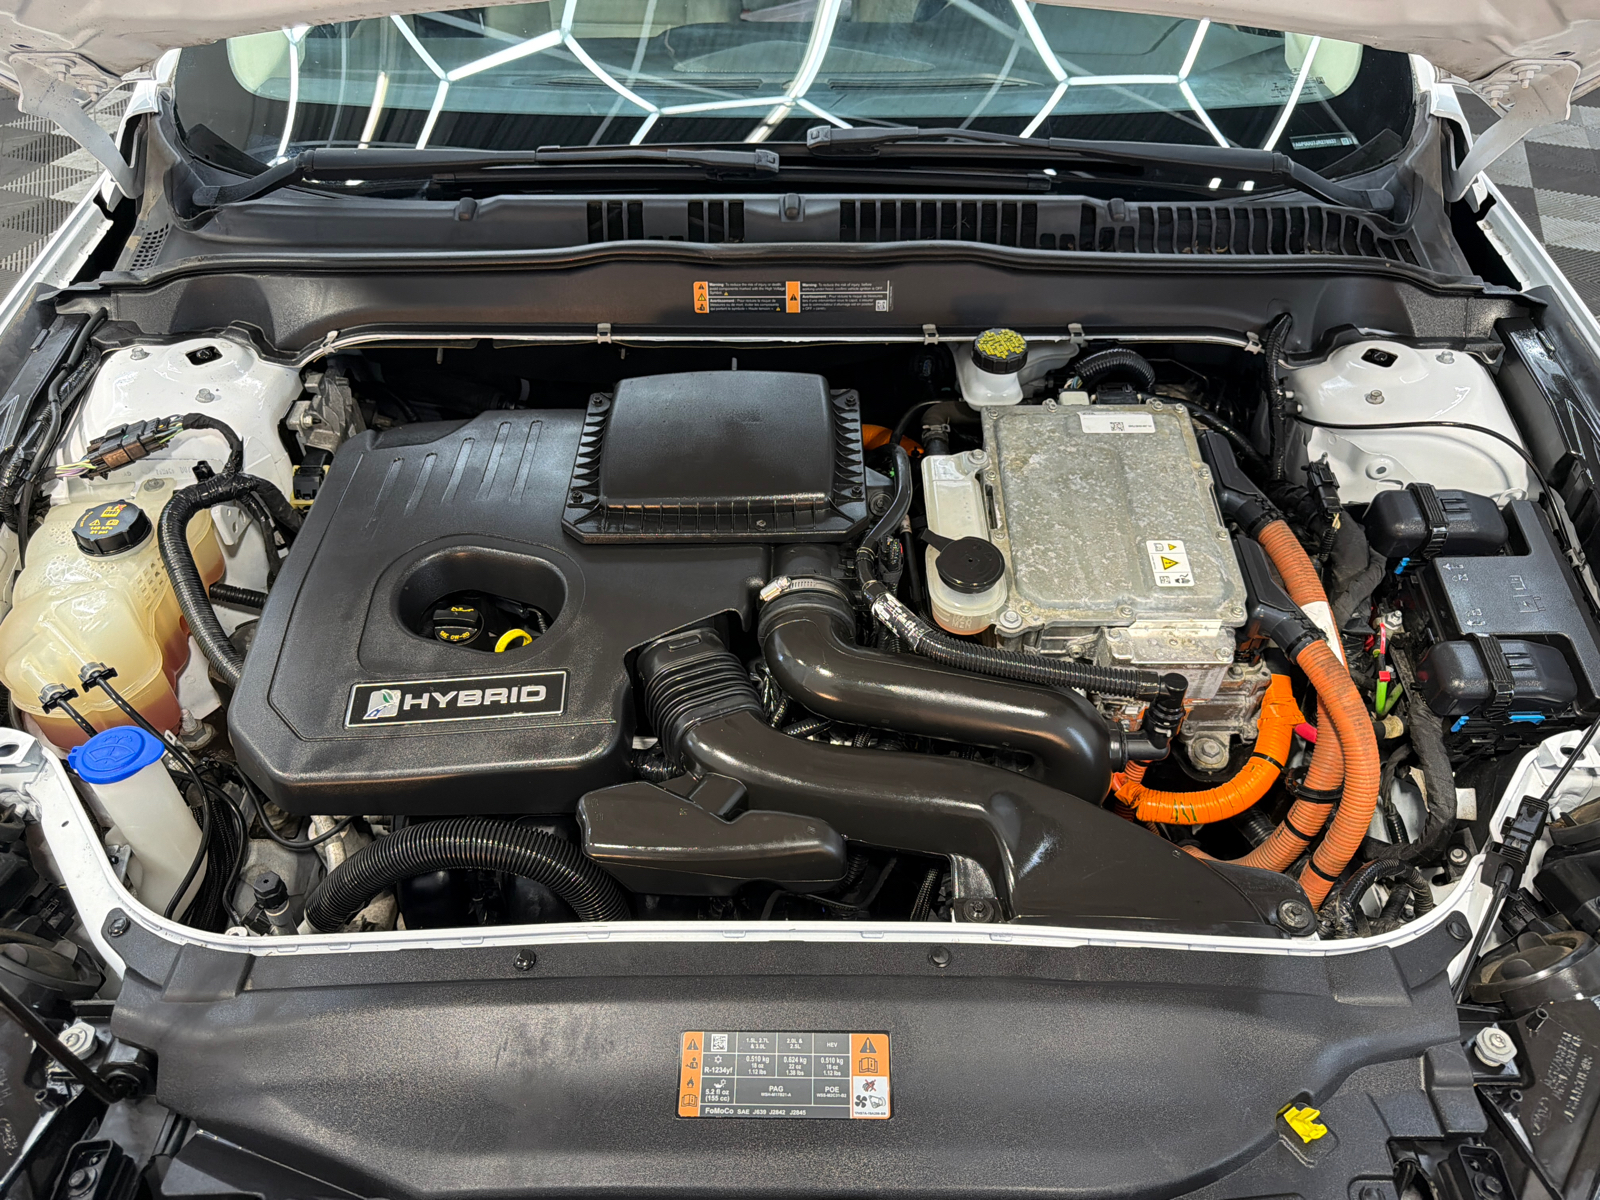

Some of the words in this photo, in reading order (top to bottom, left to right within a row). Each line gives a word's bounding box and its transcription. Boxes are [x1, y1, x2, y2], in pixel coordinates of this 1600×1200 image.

[403, 685, 547, 710] HYBRID
[762, 1055, 770, 1063] kg
[799, 1056, 807, 1064] kg
[836, 1057, 844, 1065] kg
[704, 1066, 733, 1075] R-1234yf
